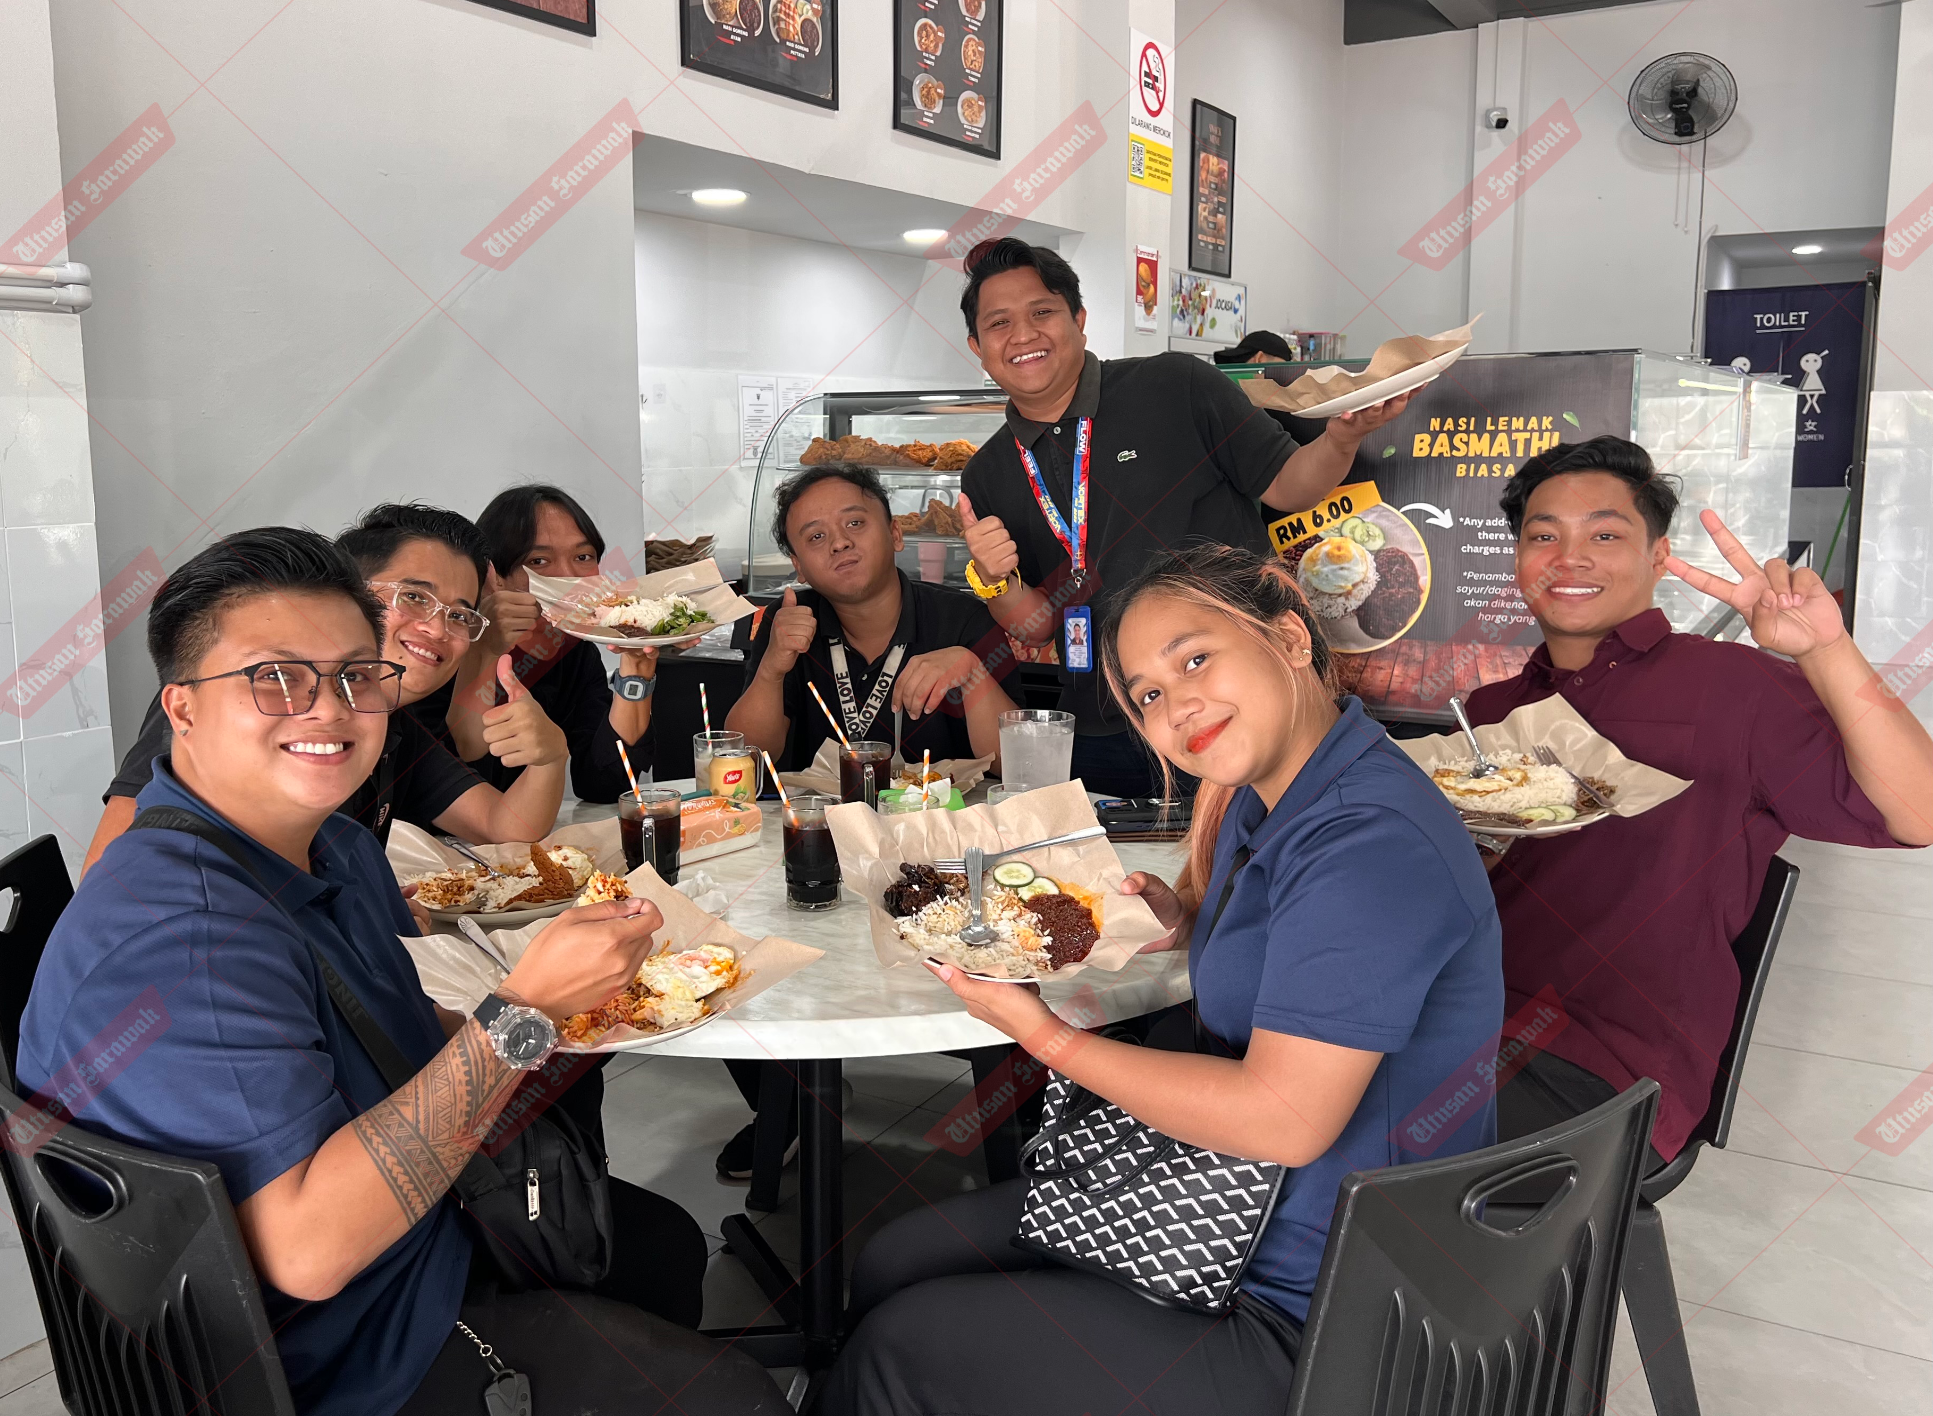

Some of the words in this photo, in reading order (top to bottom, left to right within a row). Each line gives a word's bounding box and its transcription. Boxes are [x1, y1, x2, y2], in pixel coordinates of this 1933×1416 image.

[1131, 116, 1152, 132] DILARANG
[1152, 125, 1171, 139] MEROKOK
[1753, 311, 1809, 328] TOILET
[1429, 417, 1475, 431] NASI
[1486, 416, 1553, 431] LEMAK
[1804, 419, 1817, 432] 女
[1078, 420, 1088, 454] FLOW
[1455, 463, 1516, 478] BIASA
[1077, 481, 1086, 525] VORTEX
[1275, 517, 1307, 545] RM
[1312, 496, 1353, 528] 6.00
[1485, 517, 1511, 527] add-
[1478, 531, 1505, 540] there
[1461, 544, 1500, 555] charges
[1502, 546, 1514, 554] as
[1462, 571, 1515, 582] Penamba
[1463, 598, 1489, 608] akan
[1478, 612, 1507, 624] harga
[1509, 615, 1536, 626] yang
[836, 671, 855, 704] LOVE
[870, 671, 893, 704] LOVE
[843, 705, 860, 733] OVE
